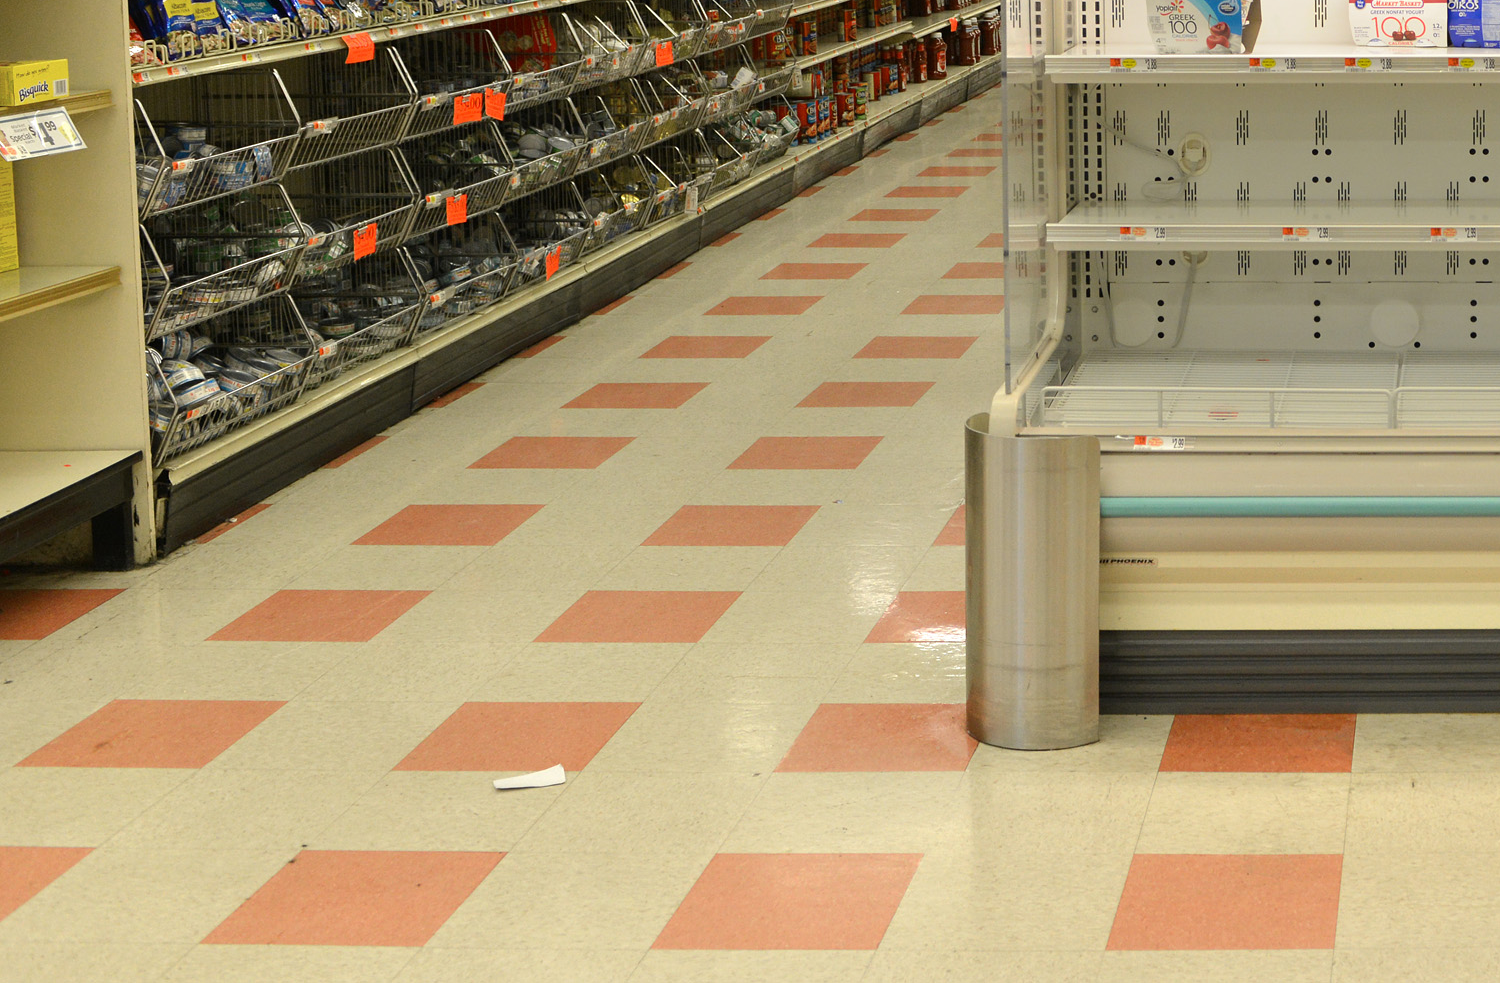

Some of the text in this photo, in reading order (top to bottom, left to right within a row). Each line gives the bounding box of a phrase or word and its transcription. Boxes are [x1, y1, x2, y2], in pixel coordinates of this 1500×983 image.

[1447, 0, 1479, 10] OIKOS
[1168, 21, 1197, 34] 100
[1371, 16, 1426, 38] 100
[19, 80, 49, 102] Bisquick
[10, 132, 32, 142] Special
